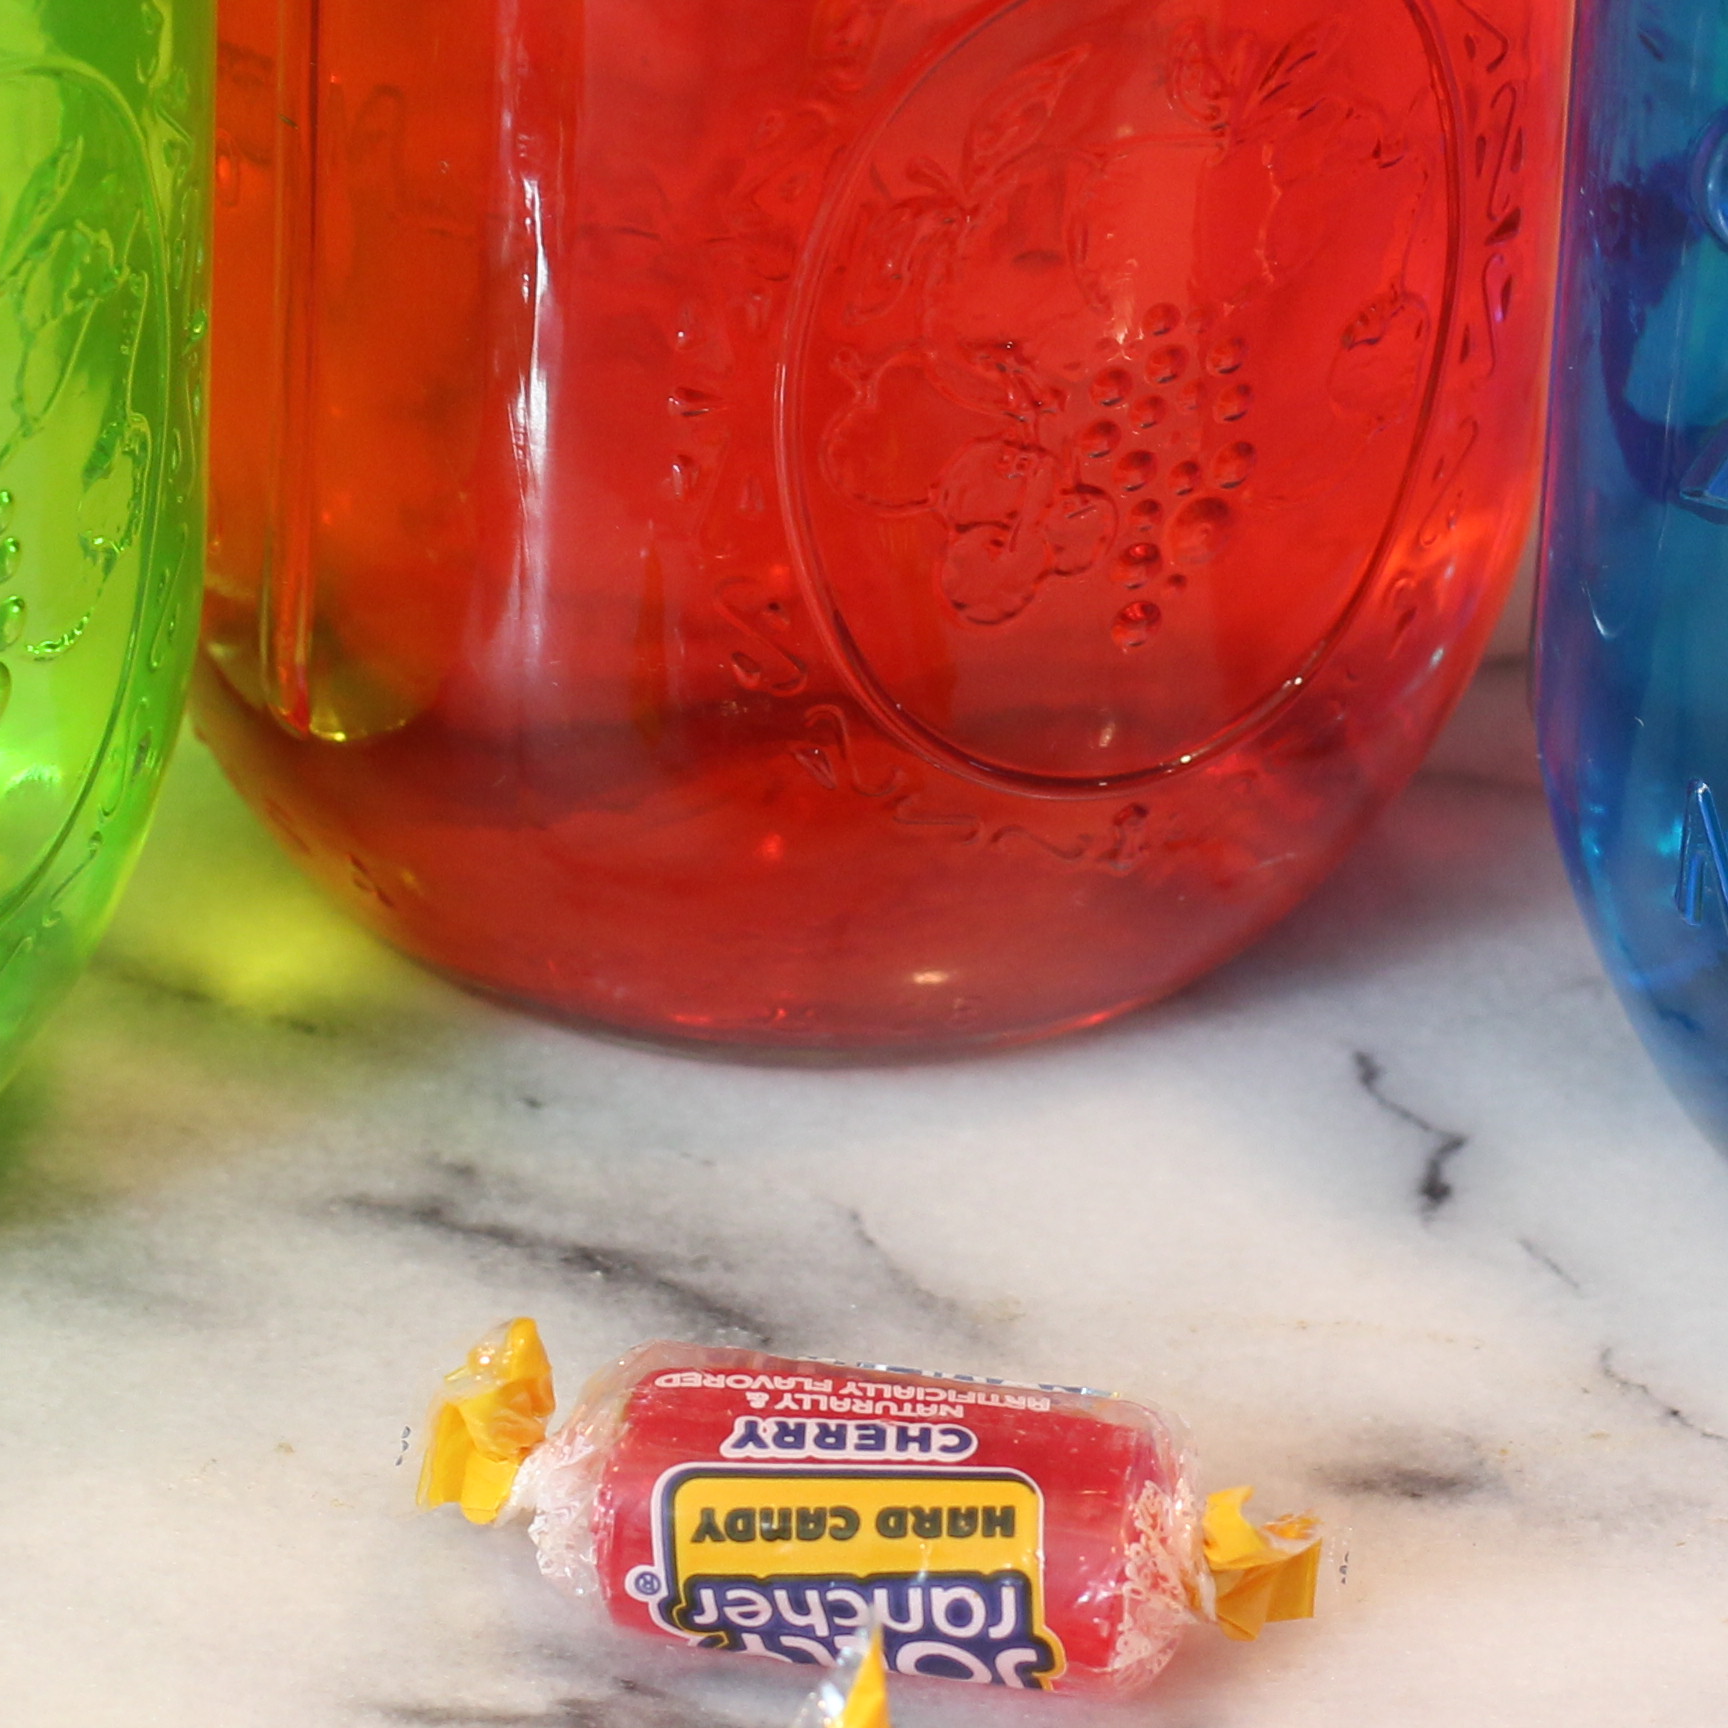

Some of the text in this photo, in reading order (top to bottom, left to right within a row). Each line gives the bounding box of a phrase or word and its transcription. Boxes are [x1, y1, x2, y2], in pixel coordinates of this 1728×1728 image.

[654, 1371, 832, 1394] FLAVORED
[839, 1380, 1051, 1413] ARTIFICIALLY
[745, 1390, 965, 1419] NATURALLY &
[731, 1418, 973, 1457] CHERRY
[690, 1504, 1016, 1544] HARD CANDY
[693, 1583, 1018, 1640] rancher
